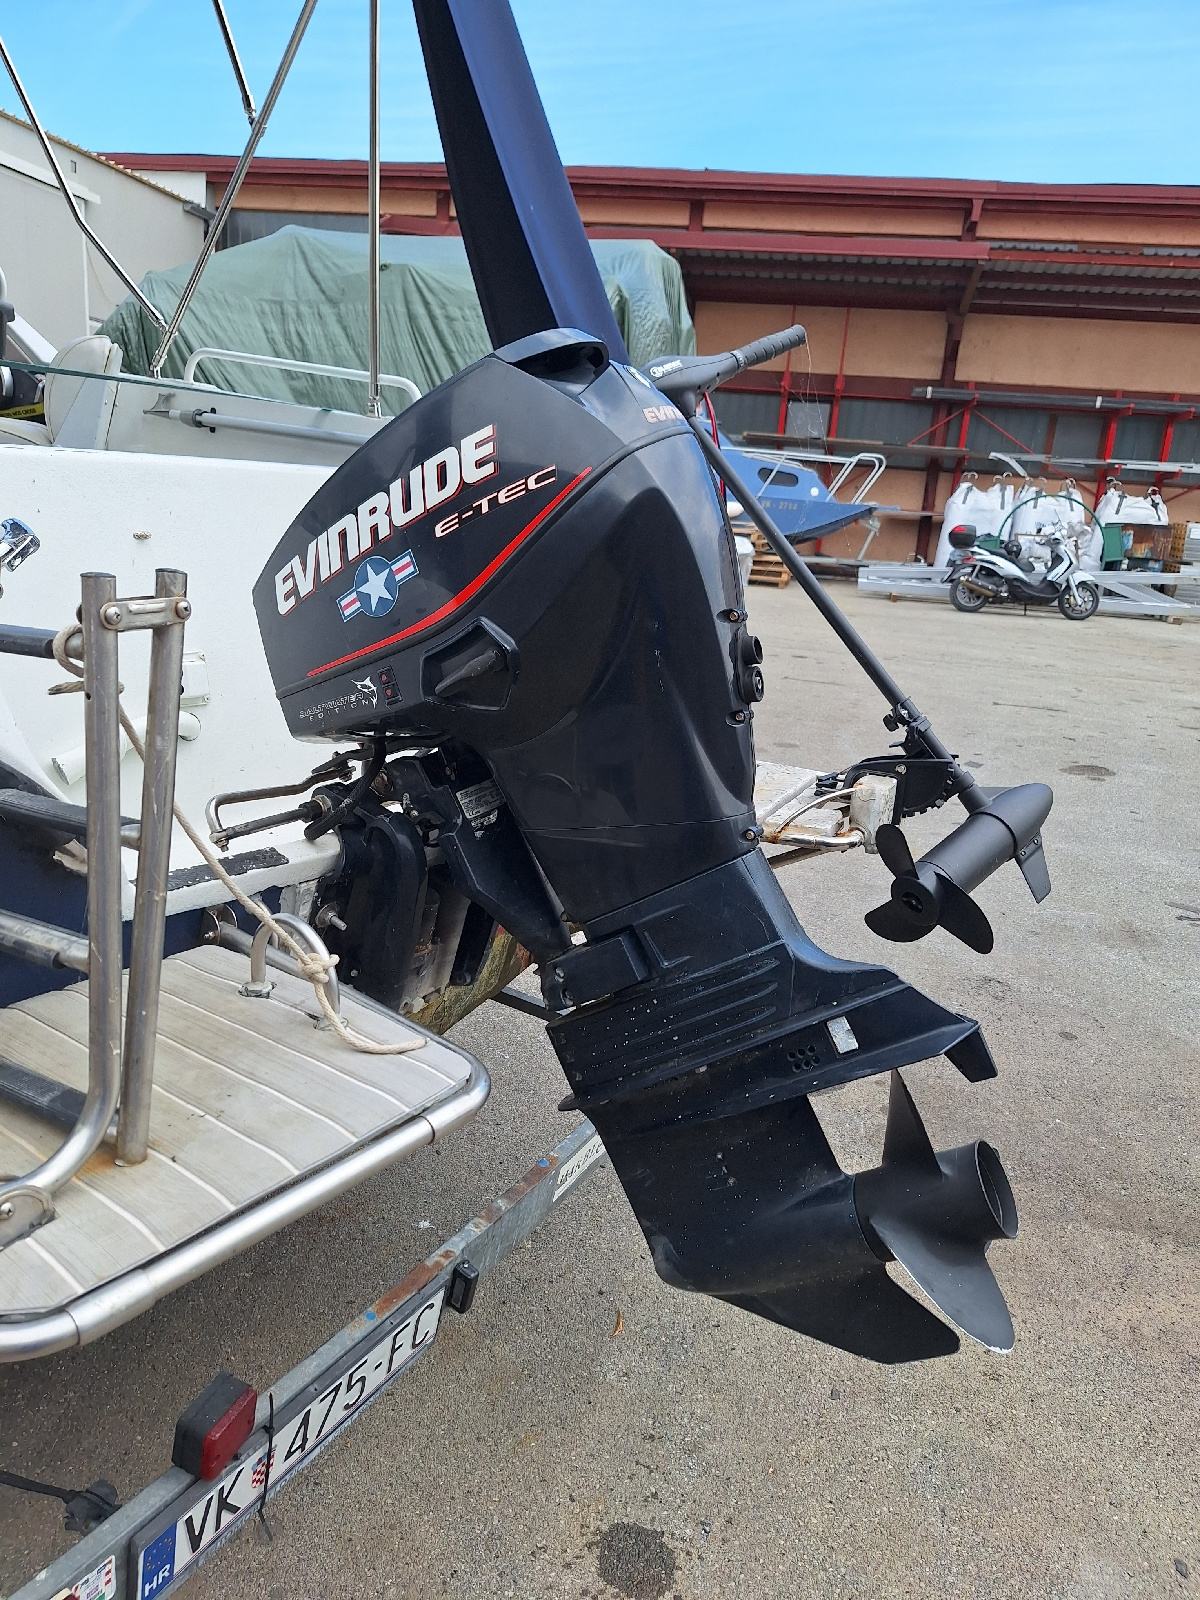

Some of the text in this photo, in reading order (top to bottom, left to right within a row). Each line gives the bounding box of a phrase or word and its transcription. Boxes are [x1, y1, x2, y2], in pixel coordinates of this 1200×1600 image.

[274, 423, 498, 616] EVINRUDE
[434, 465, 557, 538] E-TEC
[309, 699, 369, 722] EDITION
[184, 1466, 245, 1554] VK
[284, 1302, 435, 1462] 475-FC
[143, 1563, 172, 1599] HR
